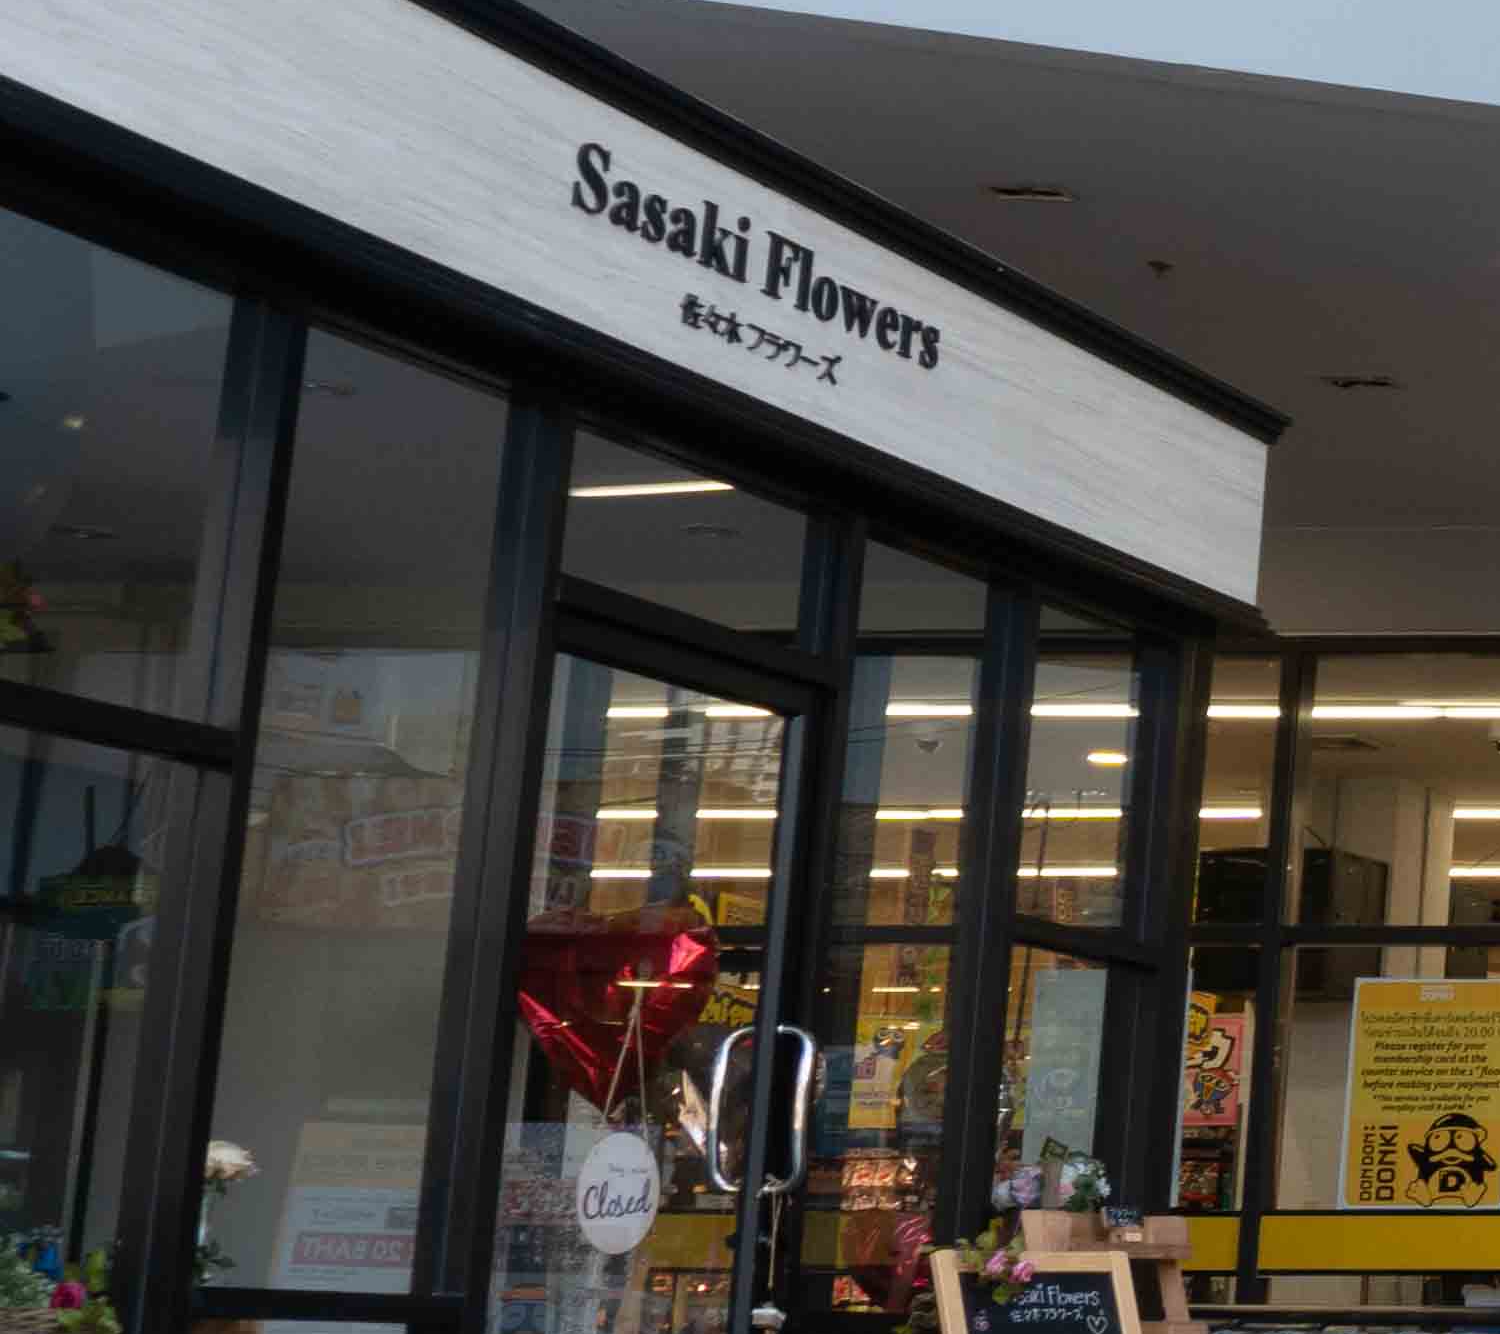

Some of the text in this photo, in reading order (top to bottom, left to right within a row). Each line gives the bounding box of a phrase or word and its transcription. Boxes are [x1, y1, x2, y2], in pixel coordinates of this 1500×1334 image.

[571, 142, 942, 370] Sasaki Flowers
[1374, 1124, 1399, 1202] DONKI
[582, 1183, 653, 1222] Closed
